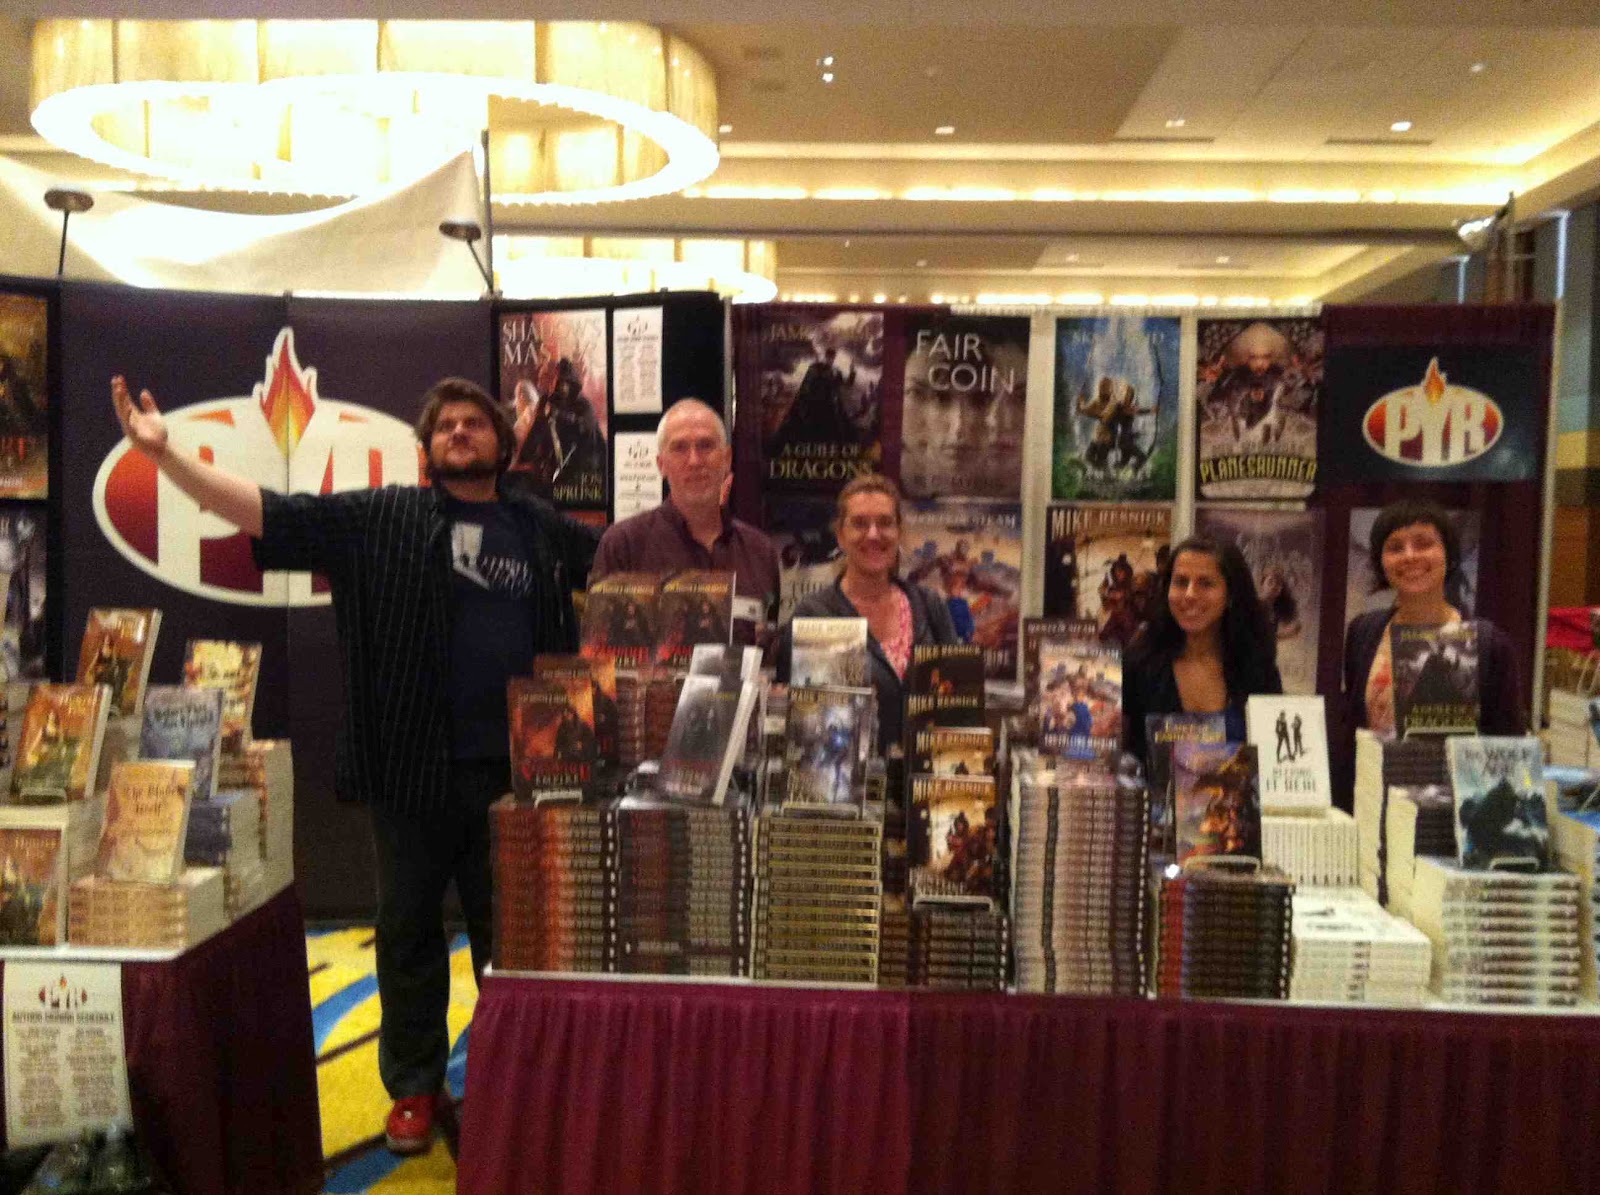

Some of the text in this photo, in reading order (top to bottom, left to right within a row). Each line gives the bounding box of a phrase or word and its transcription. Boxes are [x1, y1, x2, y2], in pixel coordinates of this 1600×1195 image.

[916, 328, 982, 361] FAIR
[928, 363, 1014, 393] COIN
[1380, 386, 1492, 466] PYR
